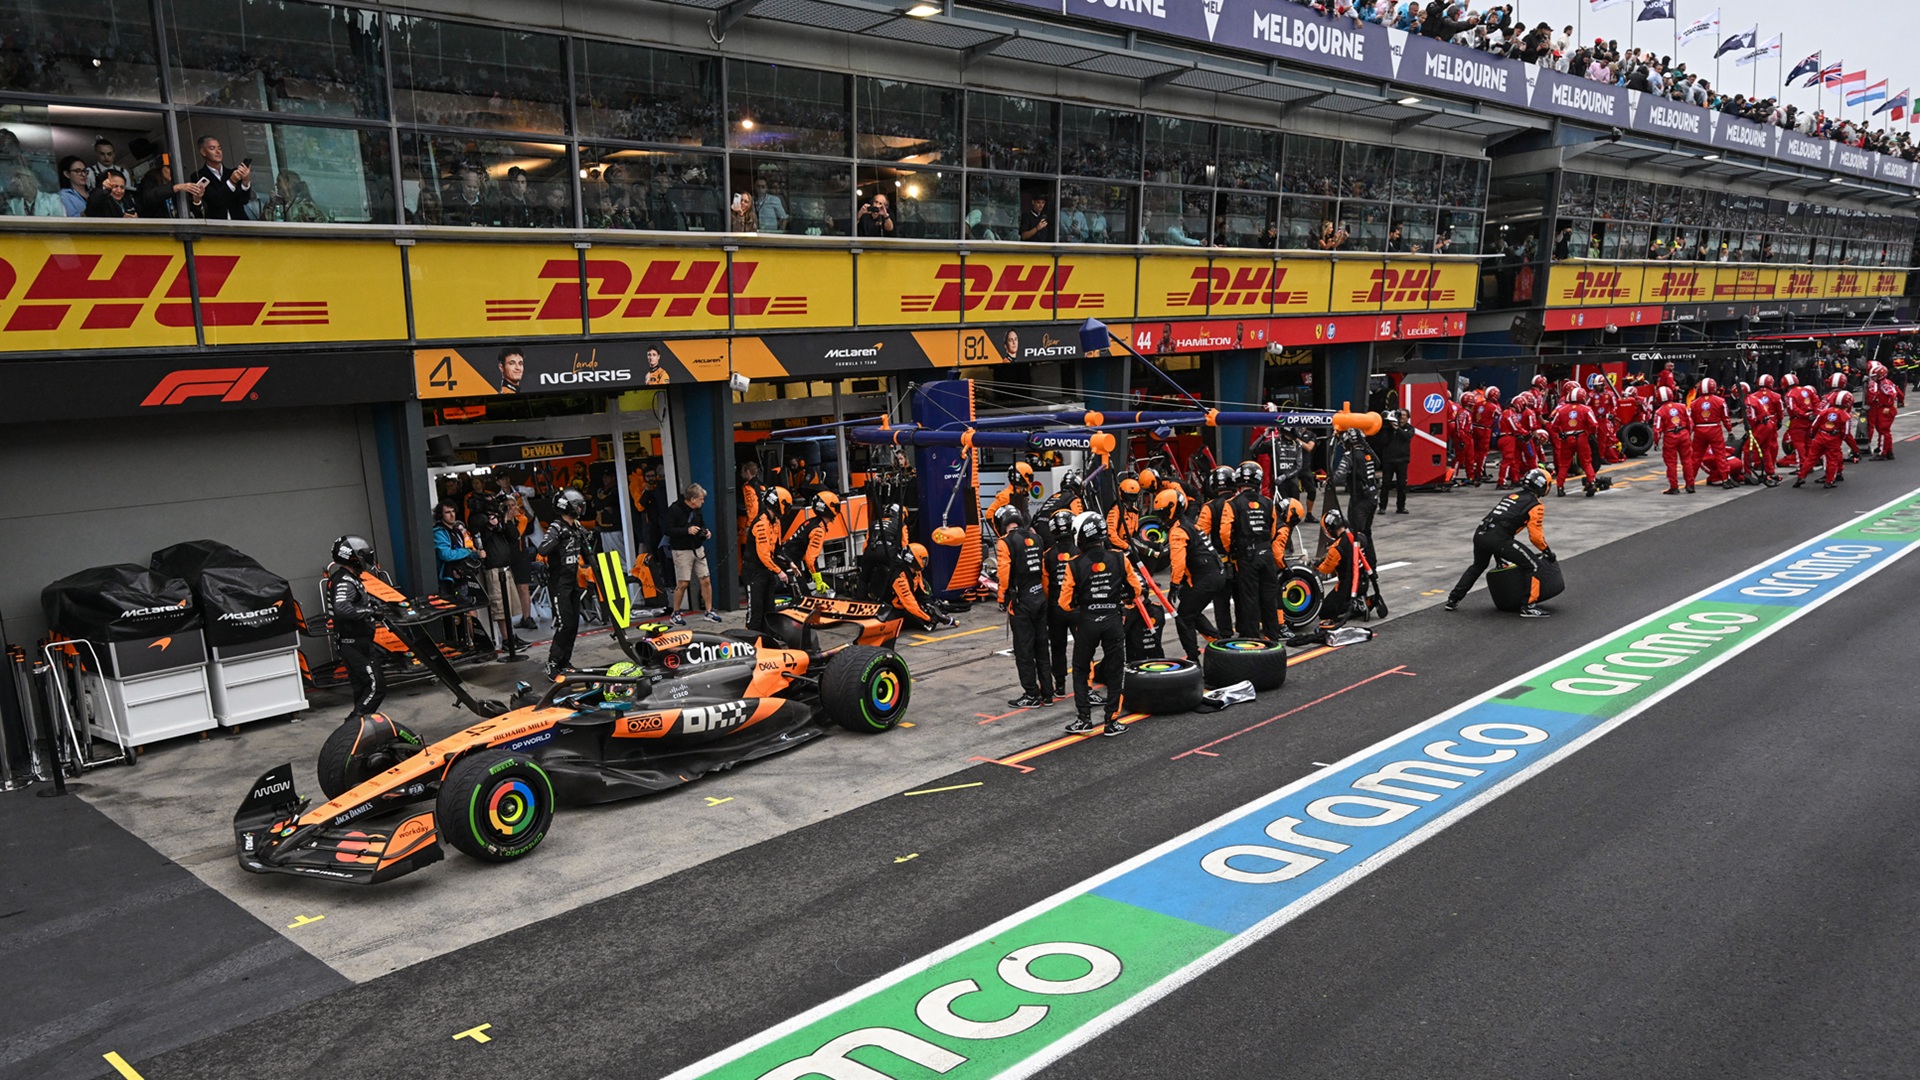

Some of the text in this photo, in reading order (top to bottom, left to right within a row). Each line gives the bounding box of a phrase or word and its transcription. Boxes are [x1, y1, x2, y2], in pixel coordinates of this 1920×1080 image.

[1253, 10, 1365, 62] MELBOURNE
[1425, 51, 1508, 92] MELBOURNE
[1552, 82, 1615, 117] MELBOURNE
[1649, 105, 1700, 134] MELBOURNE
[1726, 124, 1767, 148] MELBOURNE
[1787, 139, 1823, 161] MELBOURNE
[1839, 151, 1869, 170] MELBOURNE
[1882, 162, 1908, 179] MELBOURNE
[0, 254, 266, 331] HL
[535, 260, 771, 320] DHL
[930, 264, 1081, 312] DHL
[1187, 267, 1292, 306] DHL
[1366, 268, 1443, 303] DHL
[1572, 272, 1622, 298] DHL
[1659, 272, 1699, 297] DHL
[1380, 321, 1391, 336] 16
[1407, 327, 1439, 336] LECLERC
[964, 335, 989, 361] 81
[1137, 331, 1151, 350] 44
[1177, 337, 1231, 347] HAMILTON
[572, 348, 599, 374] Lando
[693, 356, 722, 364] McLaren
[824, 348, 878, 359] McLaren
[1024, 346, 1076, 357] PIASTRI
[1631, 352, 1662, 361] CEVA
[430, 357, 458, 391] 4
[540, 369, 631, 385] NORRIS
[1424, 394, 1444, 413] hp
[1287, 416, 1333, 425] DP WORLD
[1044, 438, 1090, 448] DP WORLD
[1739, 544, 1885, 597] aramco
[121, 604, 184, 618] McLaren
[217, 606, 278, 621] McLaren
[655, 633, 690, 647] allwyn
[686, 641, 755, 664] Chrome
[1551, 610, 1760, 697] aramco
[759, 661, 779, 672] DELL
[494, 720, 549, 741] RICHARD MILLE
[628, 716, 662, 732] OXXO
[512, 733, 551, 750] DP WORLD
[489, 758, 515, 776] PIRELLI
[409, 784, 423, 795] FIA
[1201, 722, 1549, 884] aramco
[335, 814, 350, 826] JACK
[349, 802, 373, 819] DANIEL'S
[398, 824, 430, 839] workday
